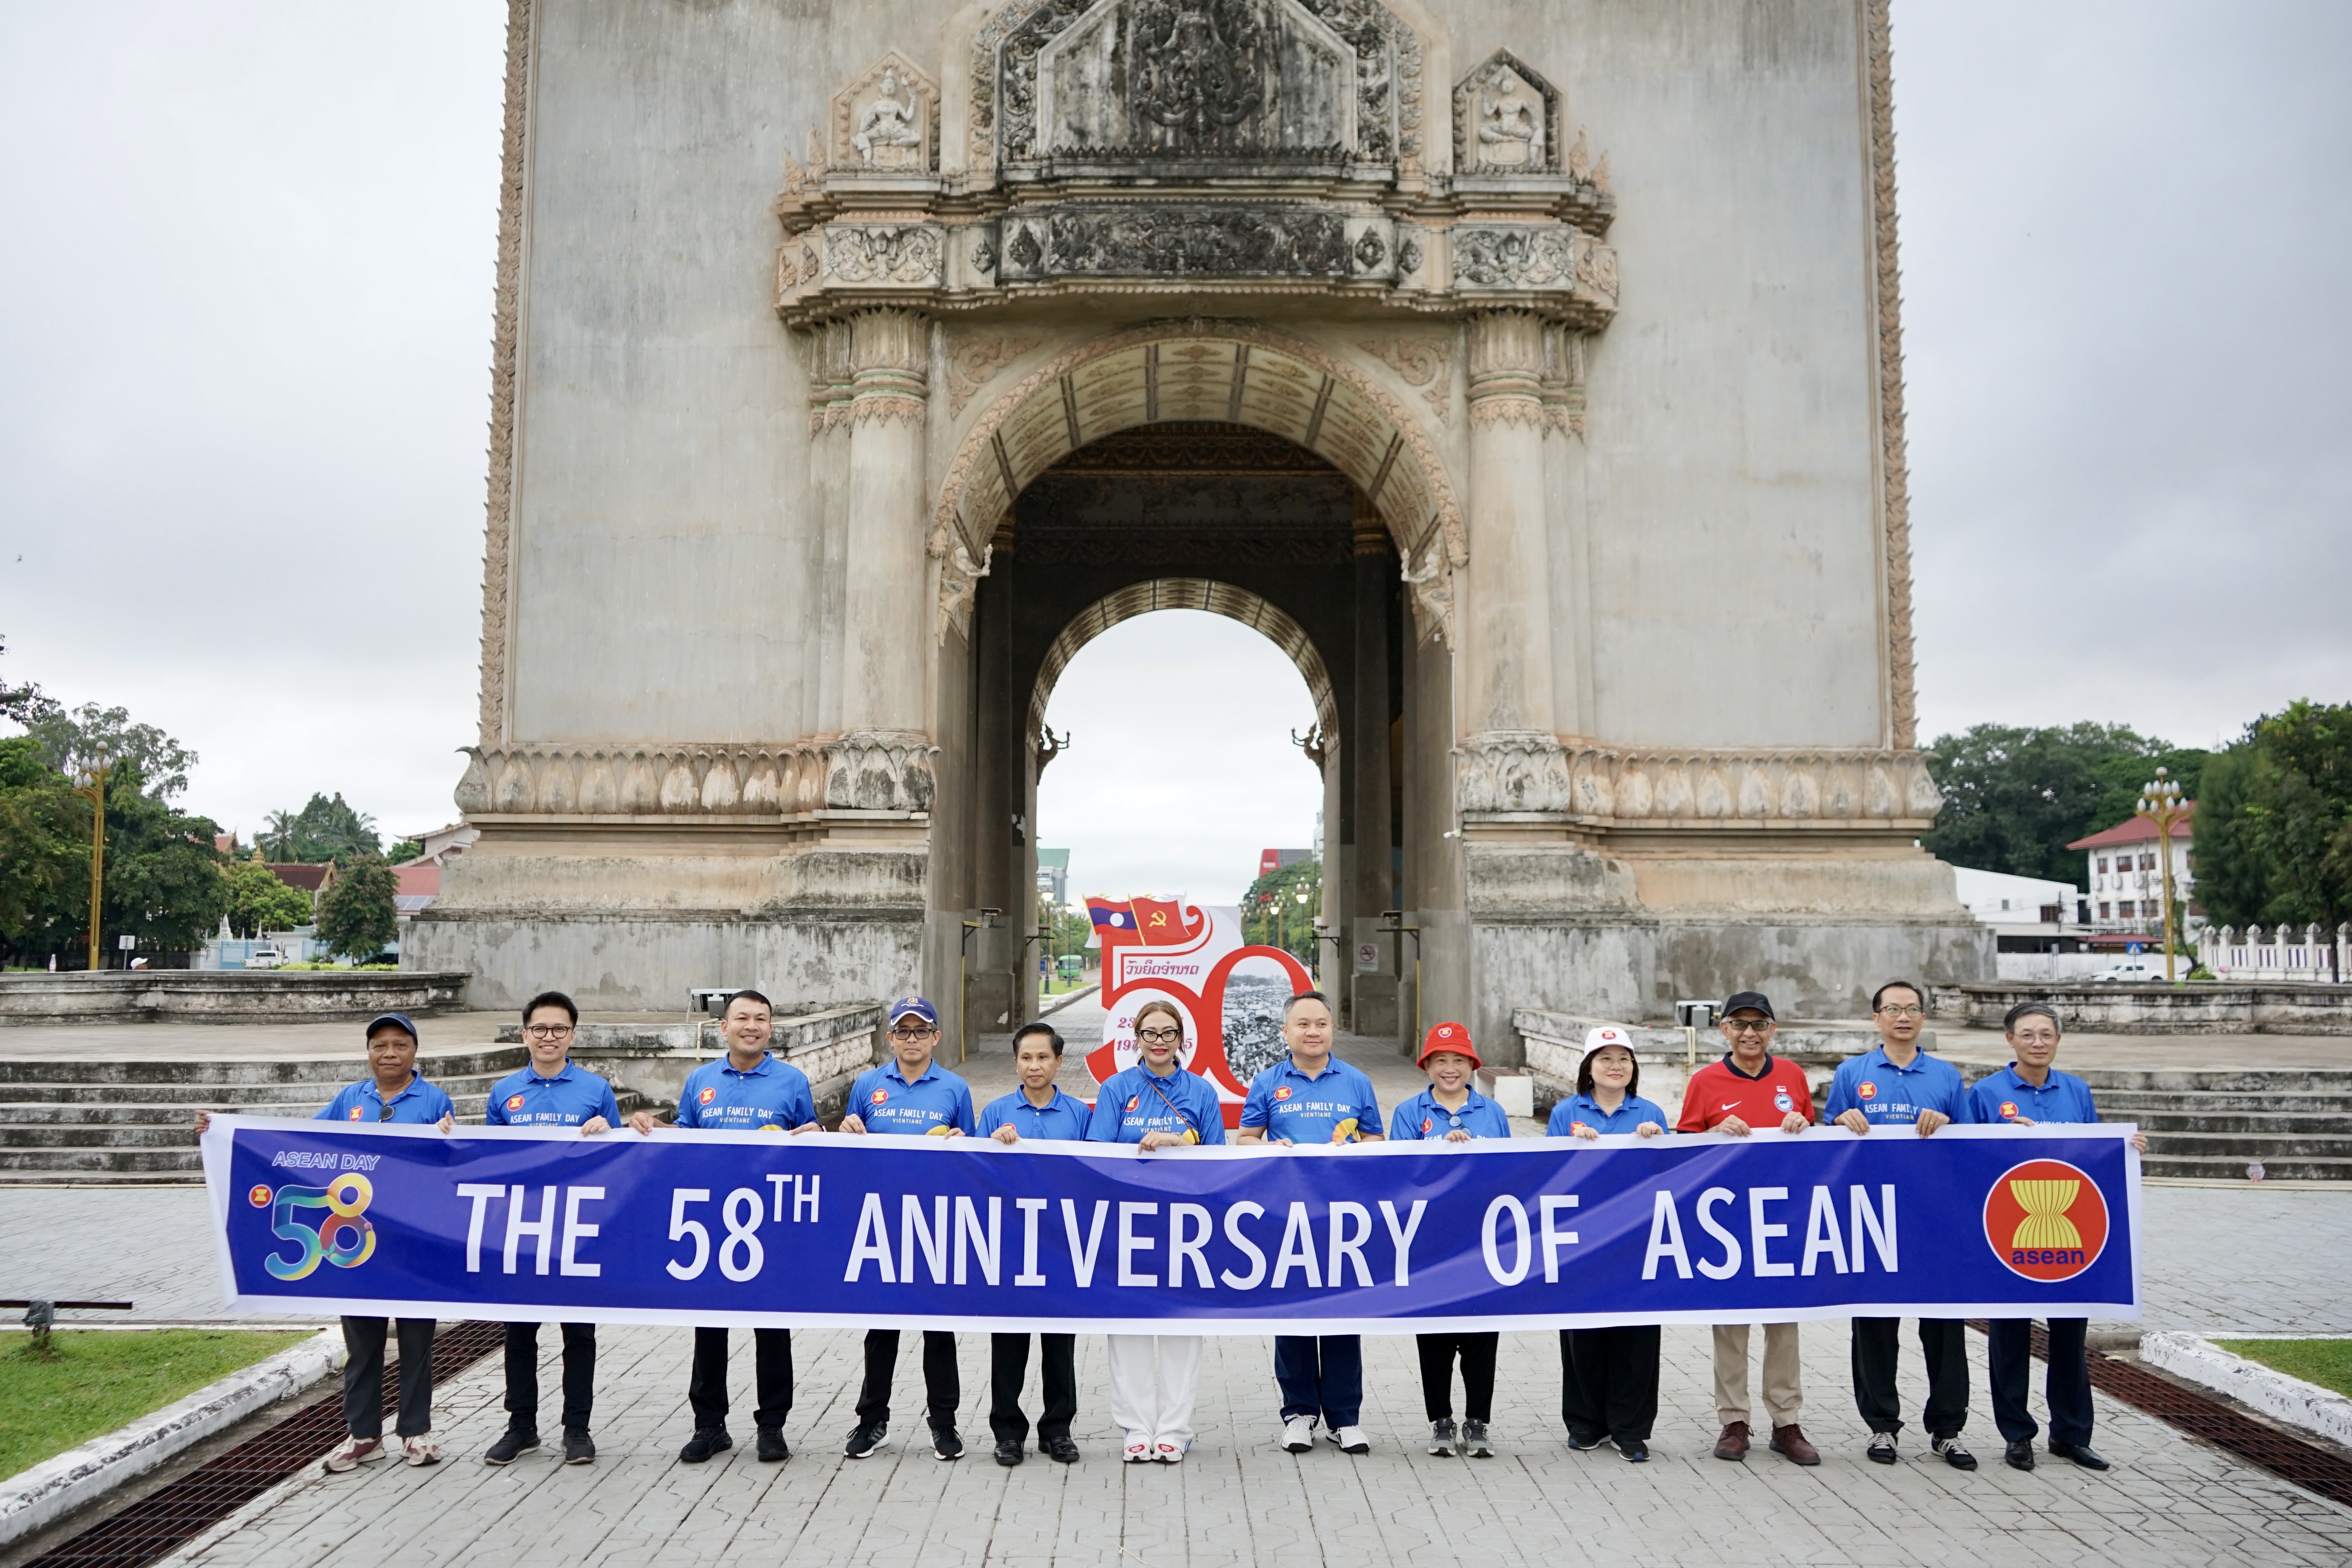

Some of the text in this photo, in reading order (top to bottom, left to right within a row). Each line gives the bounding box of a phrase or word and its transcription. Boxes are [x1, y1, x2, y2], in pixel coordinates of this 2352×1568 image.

[702, 1107, 773, 1119] ASEAN FAMILY DAY
[1279, 1102, 1351, 1114] ASEAN FAMILY DAY
[1865, 1103, 1888, 1114] ASEAN
[510, 1113, 580, 1123] ASEAN FAMILY DAY
[874, 1109, 943, 1121] ASEAN FAMILY DAY
[1148, 1116, 1172, 1126] FAMILY
[272, 1151, 380, 1170] ASEAN DAY
[264, 1173, 376, 1281] 58
[456, 1183, 605, 1277] THE
[844, 1193, 1428, 1290] ANNIVERSARY
[1482, 1194, 1579, 1286] OF
[1642, 1184, 1898, 1280] ASEAN
[2012, 1250, 2085, 1265] asean
